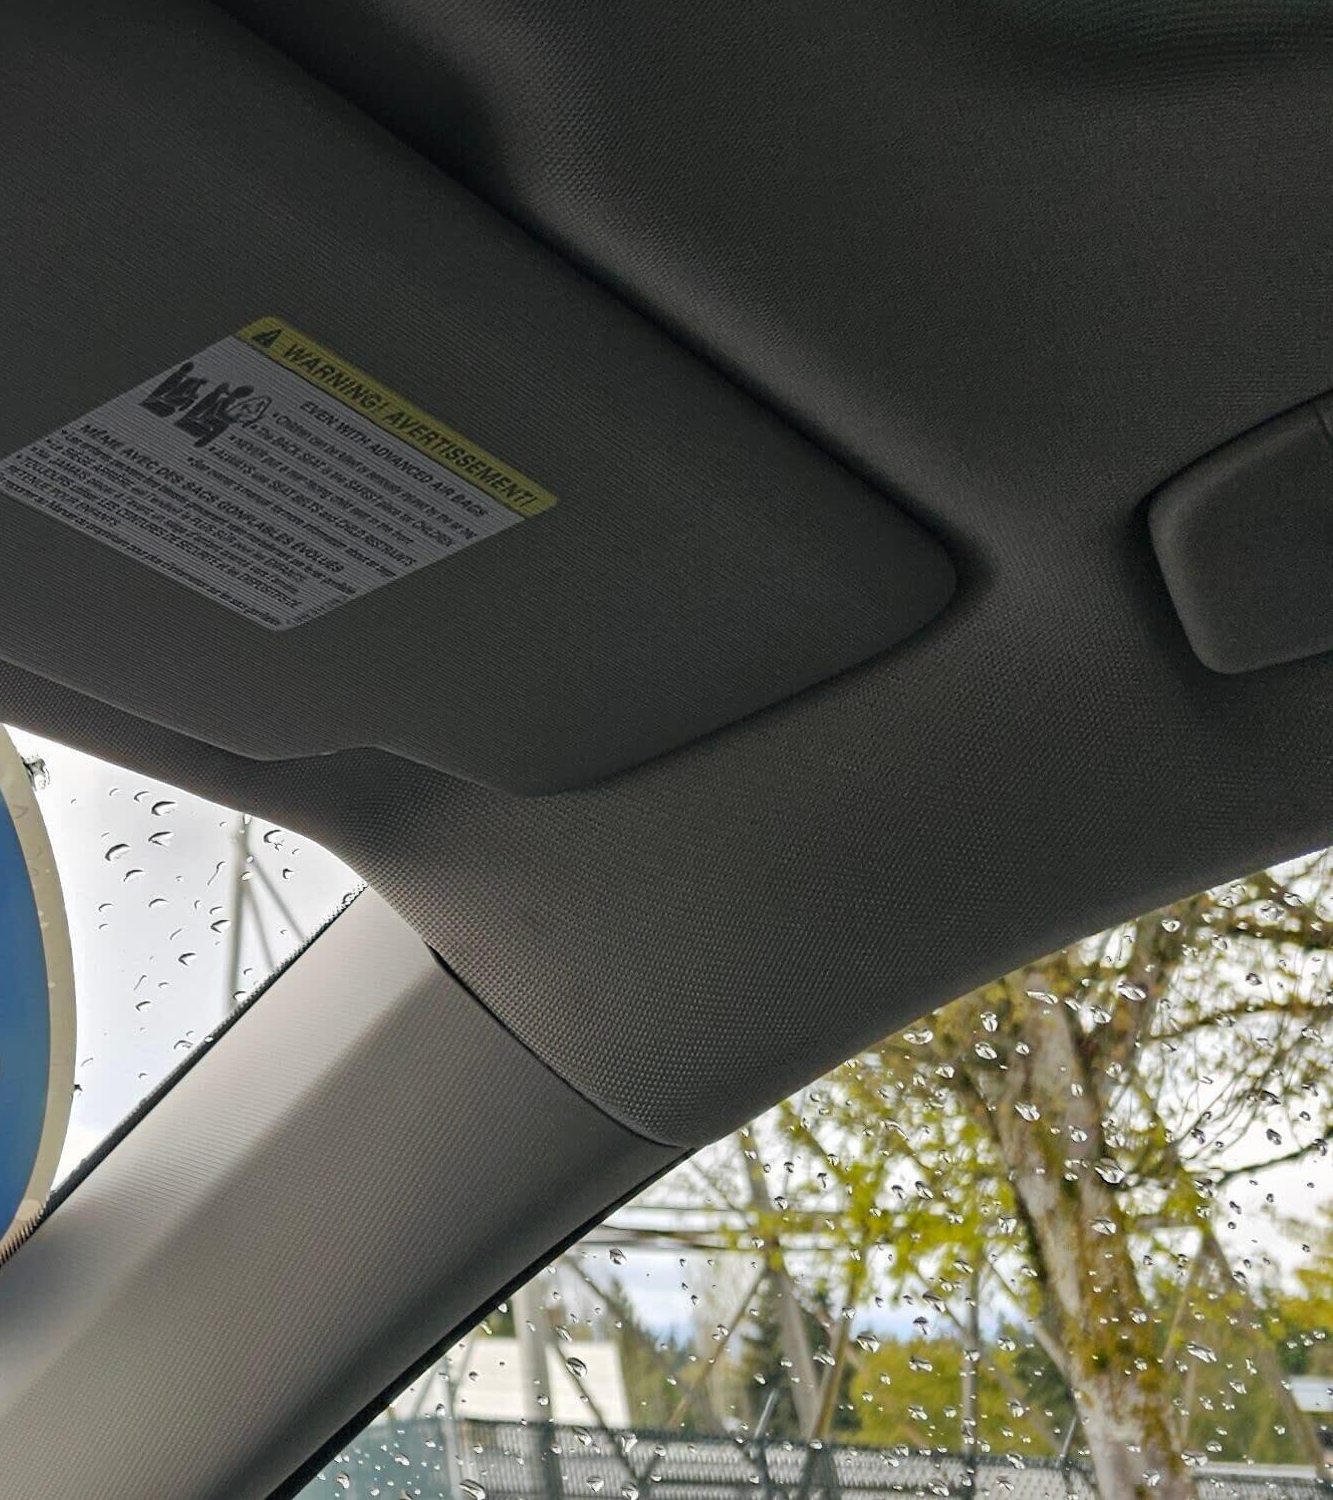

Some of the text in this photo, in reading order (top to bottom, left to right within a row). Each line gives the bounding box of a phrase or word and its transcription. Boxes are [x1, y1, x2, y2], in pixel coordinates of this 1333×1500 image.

[77, 423, 127, 450] MÊME
[119, 446, 162, 470] AVEC
[154, 466, 187, 484] DES
[181, 480, 222, 503] SACS
[269, 436, 303, 456] BACK
[295, 452, 328, 470] SEAT
[274, 342, 541, 507] WARNING! AVERTISSEMENT!
[297, 400, 490, 517] EVEN WITH ADVANCED AIR BAGS
